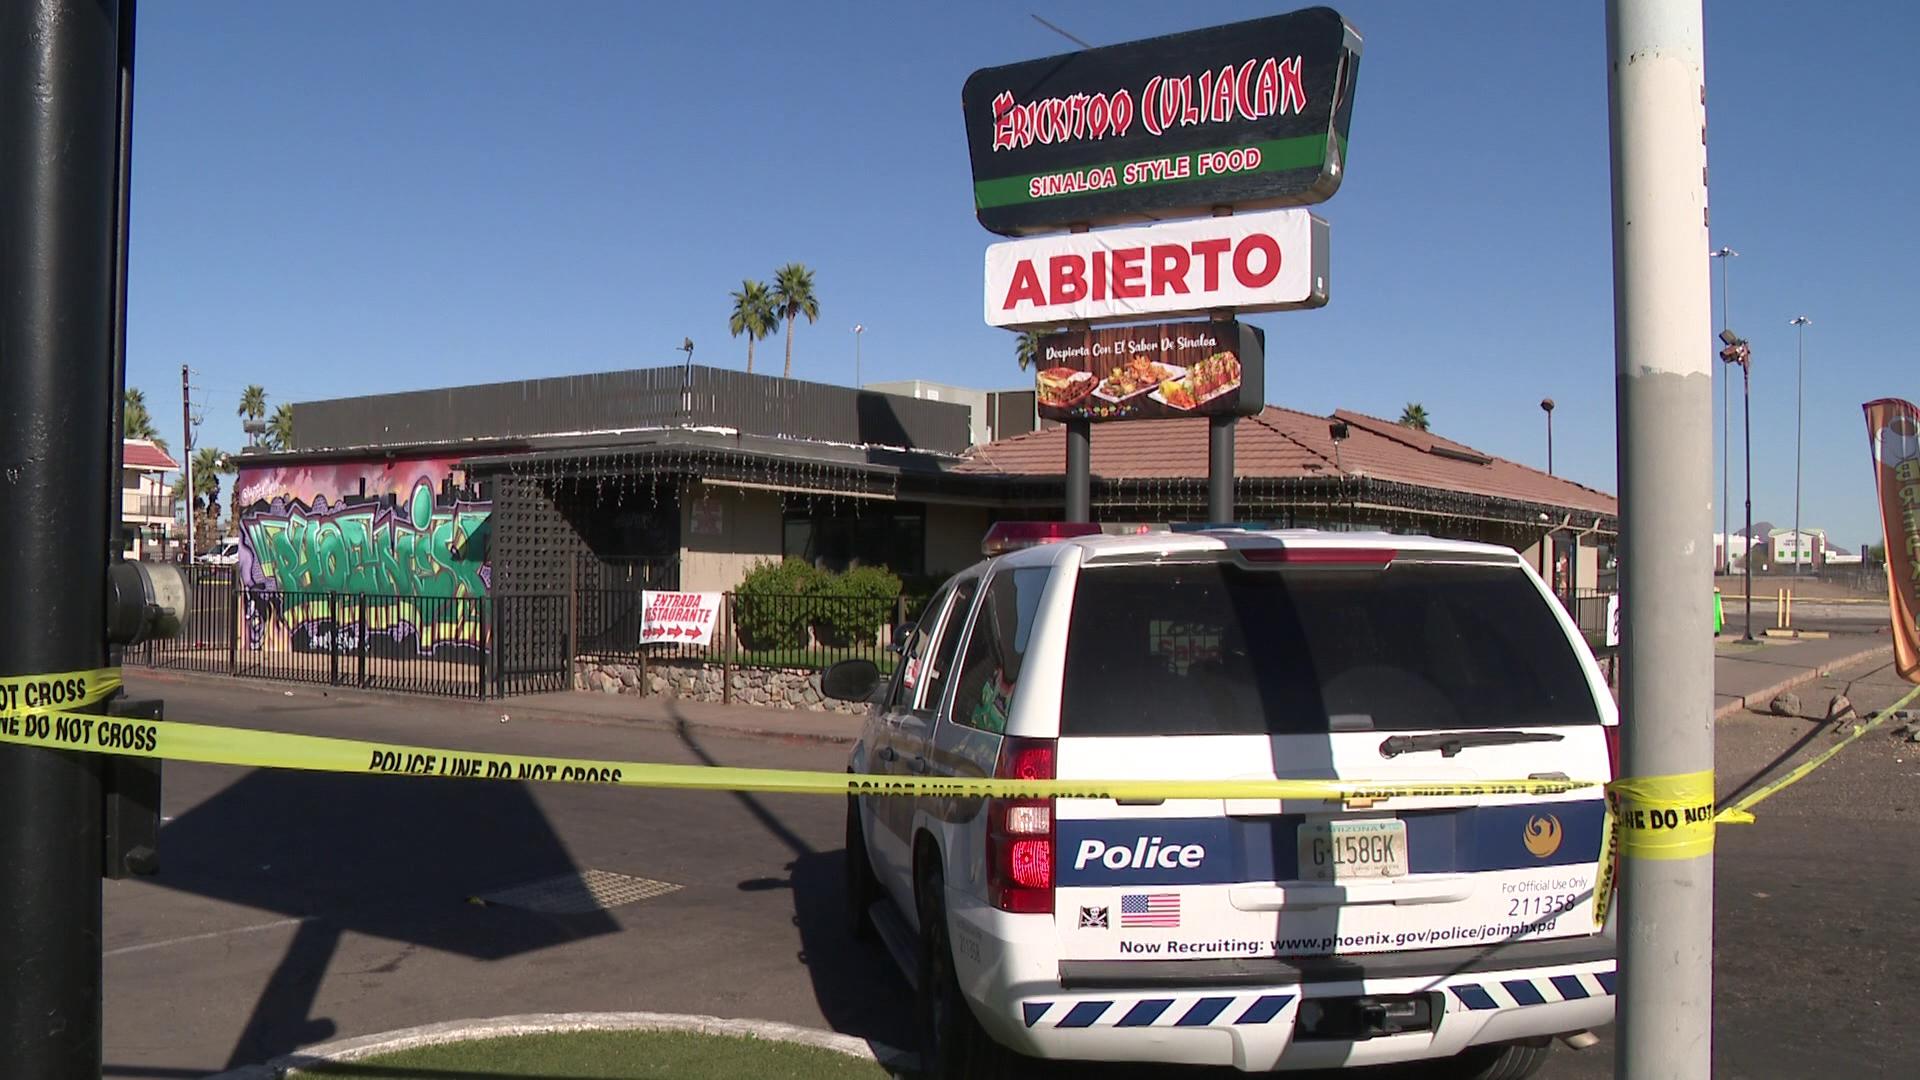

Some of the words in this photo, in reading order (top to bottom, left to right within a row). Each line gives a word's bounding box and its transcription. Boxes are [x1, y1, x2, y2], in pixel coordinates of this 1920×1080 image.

[992, 89, 1133, 152] ERICKITOO
[1141, 55, 1307, 136] CULIACAN
[1029, 166, 1117, 198] SINALOA
[1123, 156, 1190, 185] STYLE
[1198, 148, 1261, 175] FOOD
[1002, 233, 1282, 310] ABIERTO
[1045, 345, 1089, 362] Despierta
[1092, 343, 1111, 356] Con
[1114, 340, 1126, 355] El
[1127, 338, 1158, 354] Sabor
[1160, 337, 1174, 351] De
[1177, 333, 1217, 349] Sinaloa
[653, 594, 702, 607] ENTRADA
[25, 678, 86, 708] CROSS
[25, 714, 49, 739] DO
[55, 717, 94, 744] NOT
[98, 721, 157, 751] CROSS
[369, 750, 436, 774] POLICE
[439, 757, 482, 777] LINE
[486, 761, 512, 779] DO
[517, 762, 557, 780] NOT
[1650, 809, 1678, 829] DO
[1684, 804, 1712, 825] NOT
[1073, 836, 1206, 871] Police
[1502, 882, 1516, 893] For
[1518, 879, 1550, 892] Official
[1552, 878, 1567, 890] Use
[1568, 877, 1588, 891] Only
[1508, 894, 1576, 917] 211358
[1120, 940, 1161, 953] Now
[1167, 938, 1264, 954] Recruiting:
[1271, 919, 1556, 949] www.phoenix.gov/police/joinphxpd
